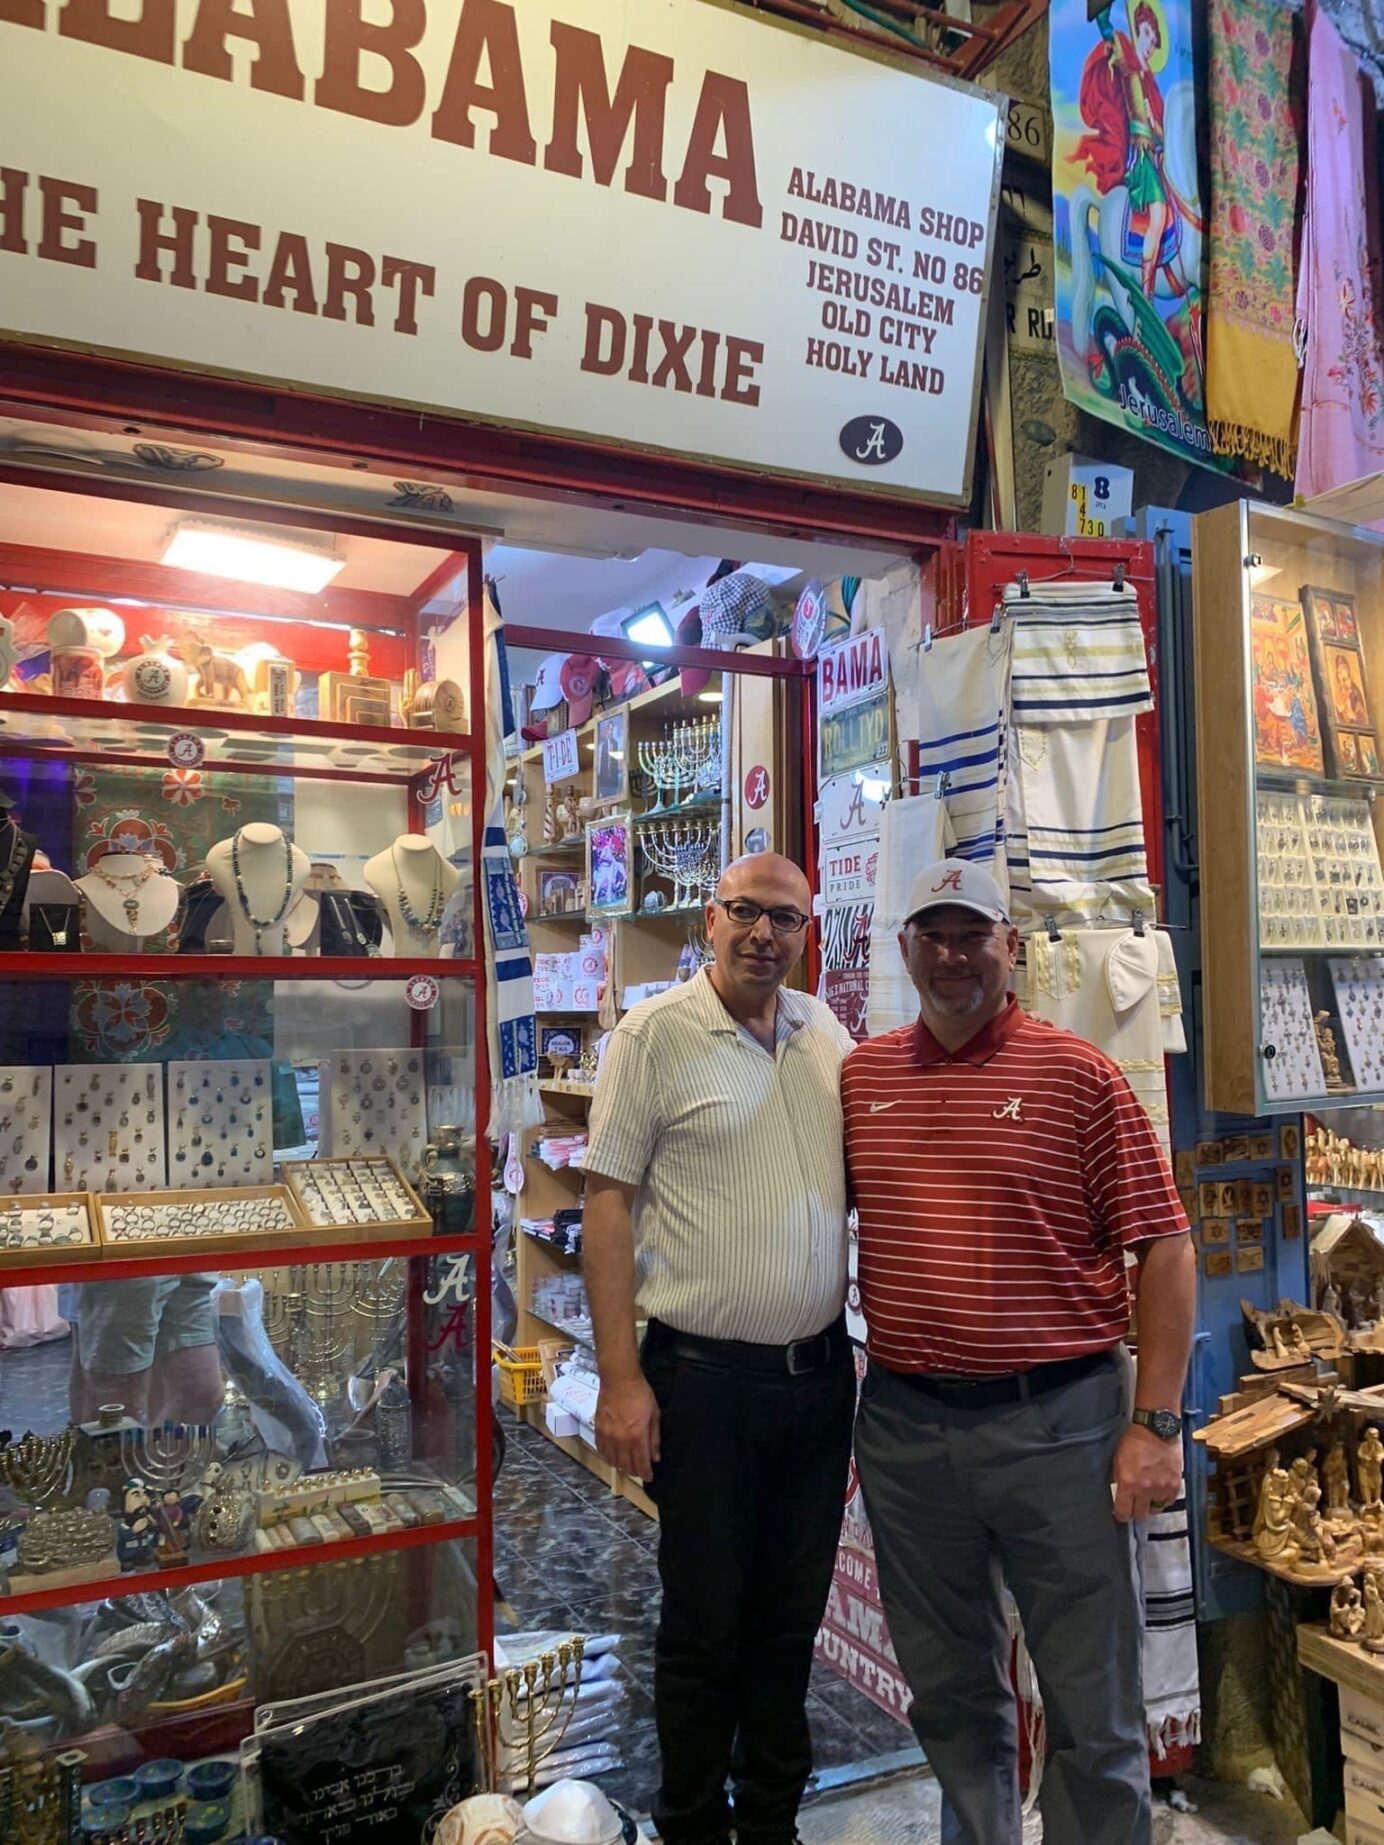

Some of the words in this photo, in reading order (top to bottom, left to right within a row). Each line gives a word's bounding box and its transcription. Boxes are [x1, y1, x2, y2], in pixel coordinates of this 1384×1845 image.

[0, 0, 763, 229] ABAMA
[1008, 110, 1040, 146] 86
[787, 167, 911, 230] ALABAMA
[919, 207, 985, 249] SHOP
[780, 211, 858, 259] DAVID
[867, 237, 903, 274] ST.
[913, 251, 946, 284] NO
[953, 262, 985, 294] 86
[135, 198, 436, 336] HEART
[461, 276, 558, 360] OF
[580, 302, 764, 407] DIXIE
[806, 260, 955, 325] JERUSALEM
[822, 300, 871, 337] OLD
[879, 315, 937, 354] CITY
[806, 337, 873, 378] HOLY
[879, 355, 945, 395] LAND
[856, 422, 886, 459] A
[1119, 383, 1212, 452] Jerusalem
[823, 635, 883, 703] BAMA
[416, 752, 462, 804] A
[748, 770, 767, 805] A
[840, 779, 867, 829] A
[829, 855, 861, 877] TIDE
[829, 879, 861, 893] PRIDE
[931, 868, 963, 892] A
[993, 1096, 1022, 1121] A
[423, 1253, 470, 1305] A
[425, 1302, 467, 1351] A
[835, 1551, 872, 1591] COME
